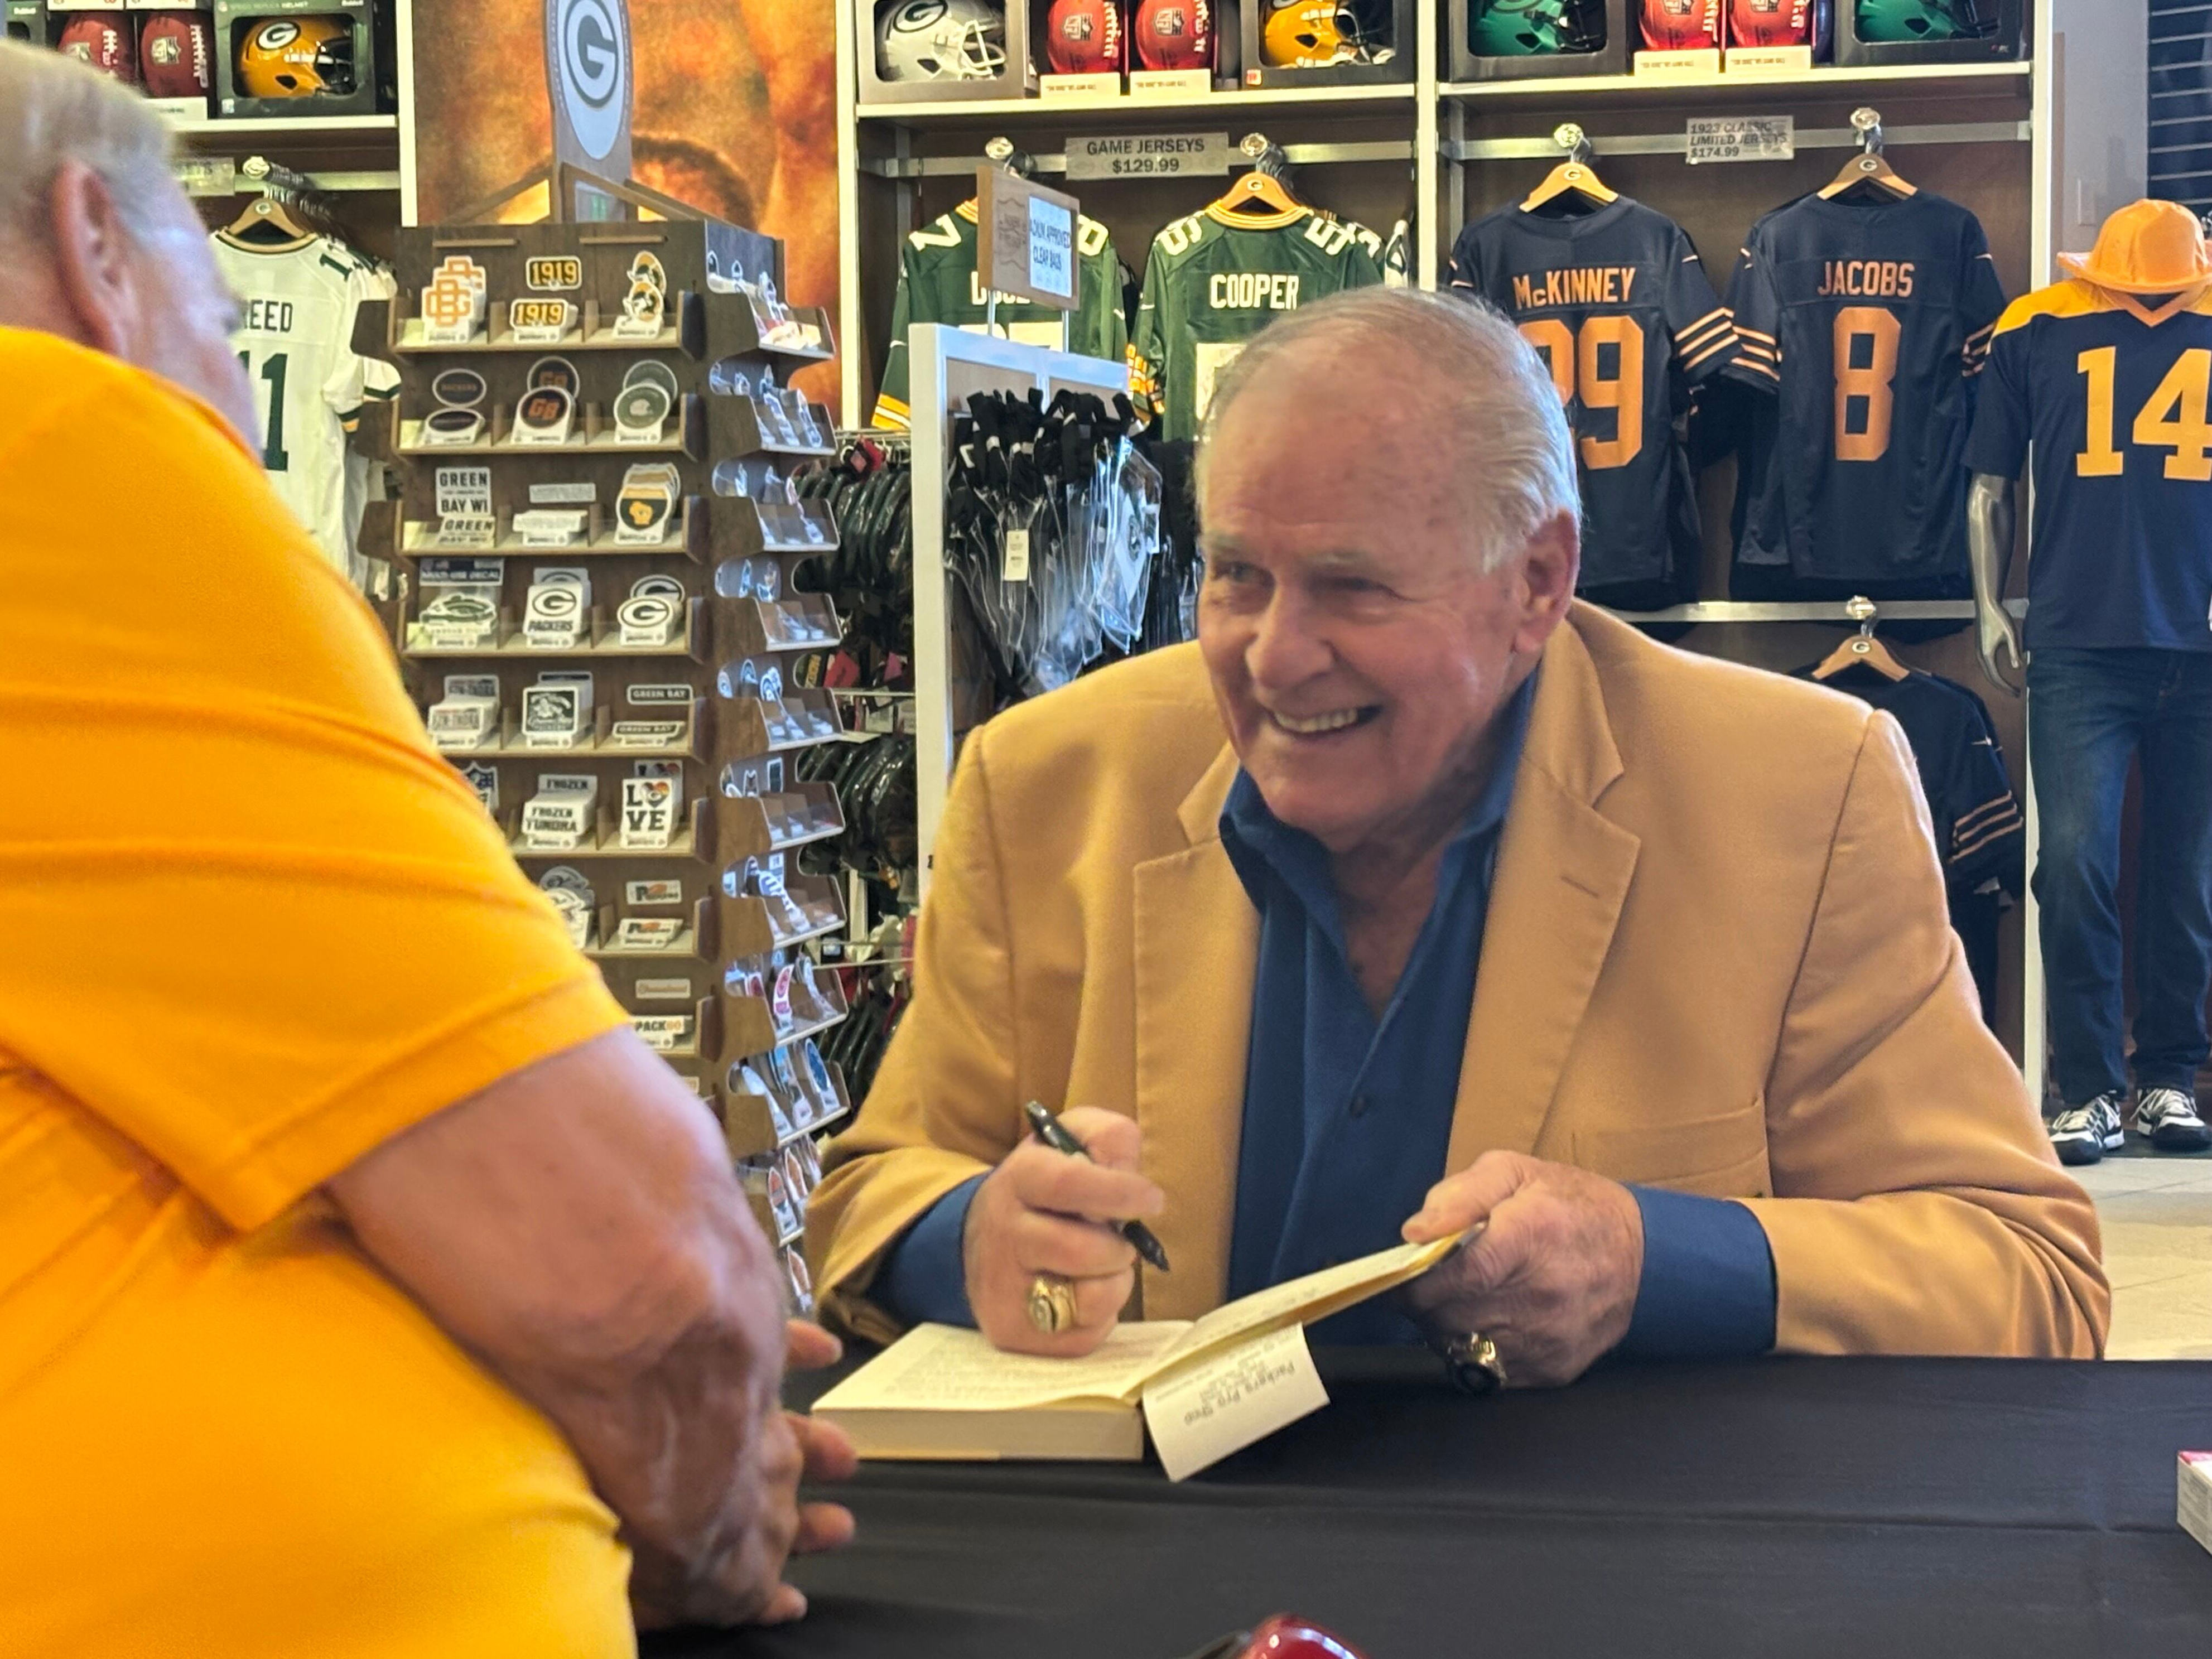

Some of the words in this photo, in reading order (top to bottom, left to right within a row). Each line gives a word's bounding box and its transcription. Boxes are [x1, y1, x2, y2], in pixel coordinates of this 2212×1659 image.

[1691, 122, 1721, 134] 1923
[1087, 140, 1132, 155] GAME
[1136, 138, 1205, 154] JERSEYS
[1690, 134, 1736, 146] LIMITED
[1691, 146, 1739, 158] $174.99
[1112, 158, 1179, 173] $129.99
[532, 260, 577, 285] 1919
[1817, 261, 1915, 297] JACOBS
[1210, 273, 1300, 310] COOPER
[1512, 267, 1636, 310] McKINNEY
[243, 299, 293, 333] EED
[517, 302, 563, 326] 1919
[1833, 306, 1901, 461] 8
[2076, 345, 2212, 481] 14
[440, 472, 488, 487] GREEN
[441, 499, 466, 513] BAY
[470, 499, 488, 513] WI
[445, 519, 493, 531] GREEN
[528, 620, 574, 632] PACKERS
[633, 688, 664, 699] GREEN
[667, 688, 687, 698] BAY
[619, 725, 650, 734] GREEN
[653, 725, 673, 734] BAY
[546, 779, 589, 790] FROZEN
[531, 807, 574, 818] FROZEN
[526, 820, 578, 833] TUNDRA
[1245, 1359, 1295, 1393] Packers
[1218, 1388, 1241, 1409] Pro
